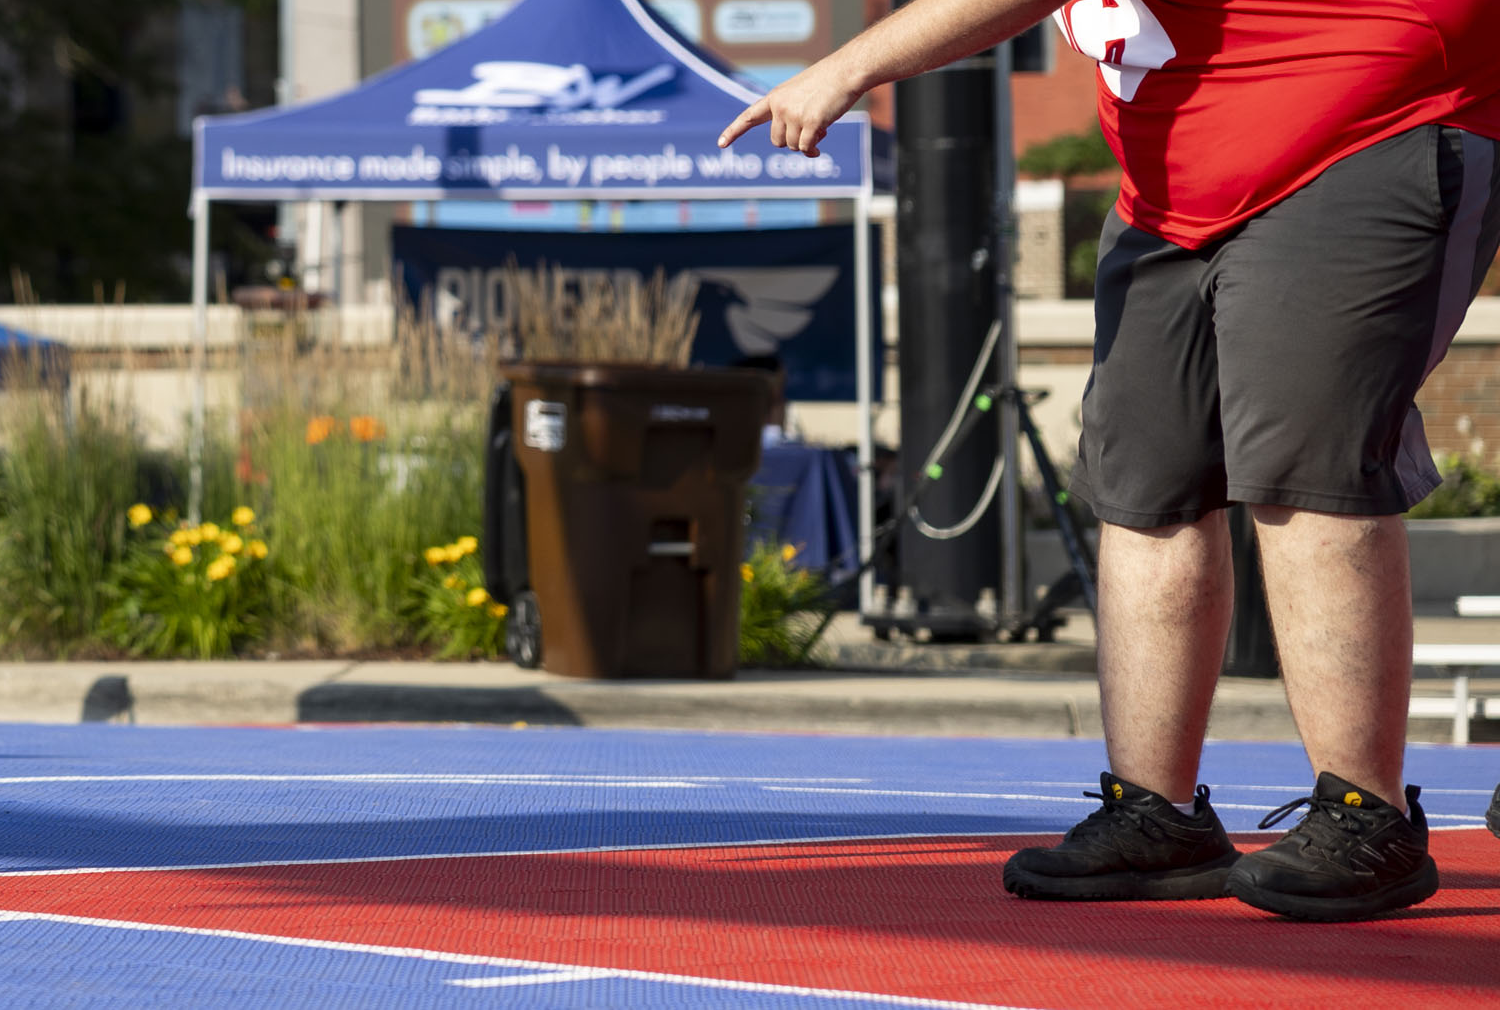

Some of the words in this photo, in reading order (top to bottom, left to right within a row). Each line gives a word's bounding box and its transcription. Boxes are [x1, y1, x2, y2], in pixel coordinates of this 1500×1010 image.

[222, 147, 356, 181] Insurance
[359, 145, 442, 181] made
[445, 144, 543, 187] simple,
[547, 144, 588, 187] by
[592, 143, 693, 186] people
[697, 145, 763, 179] who
